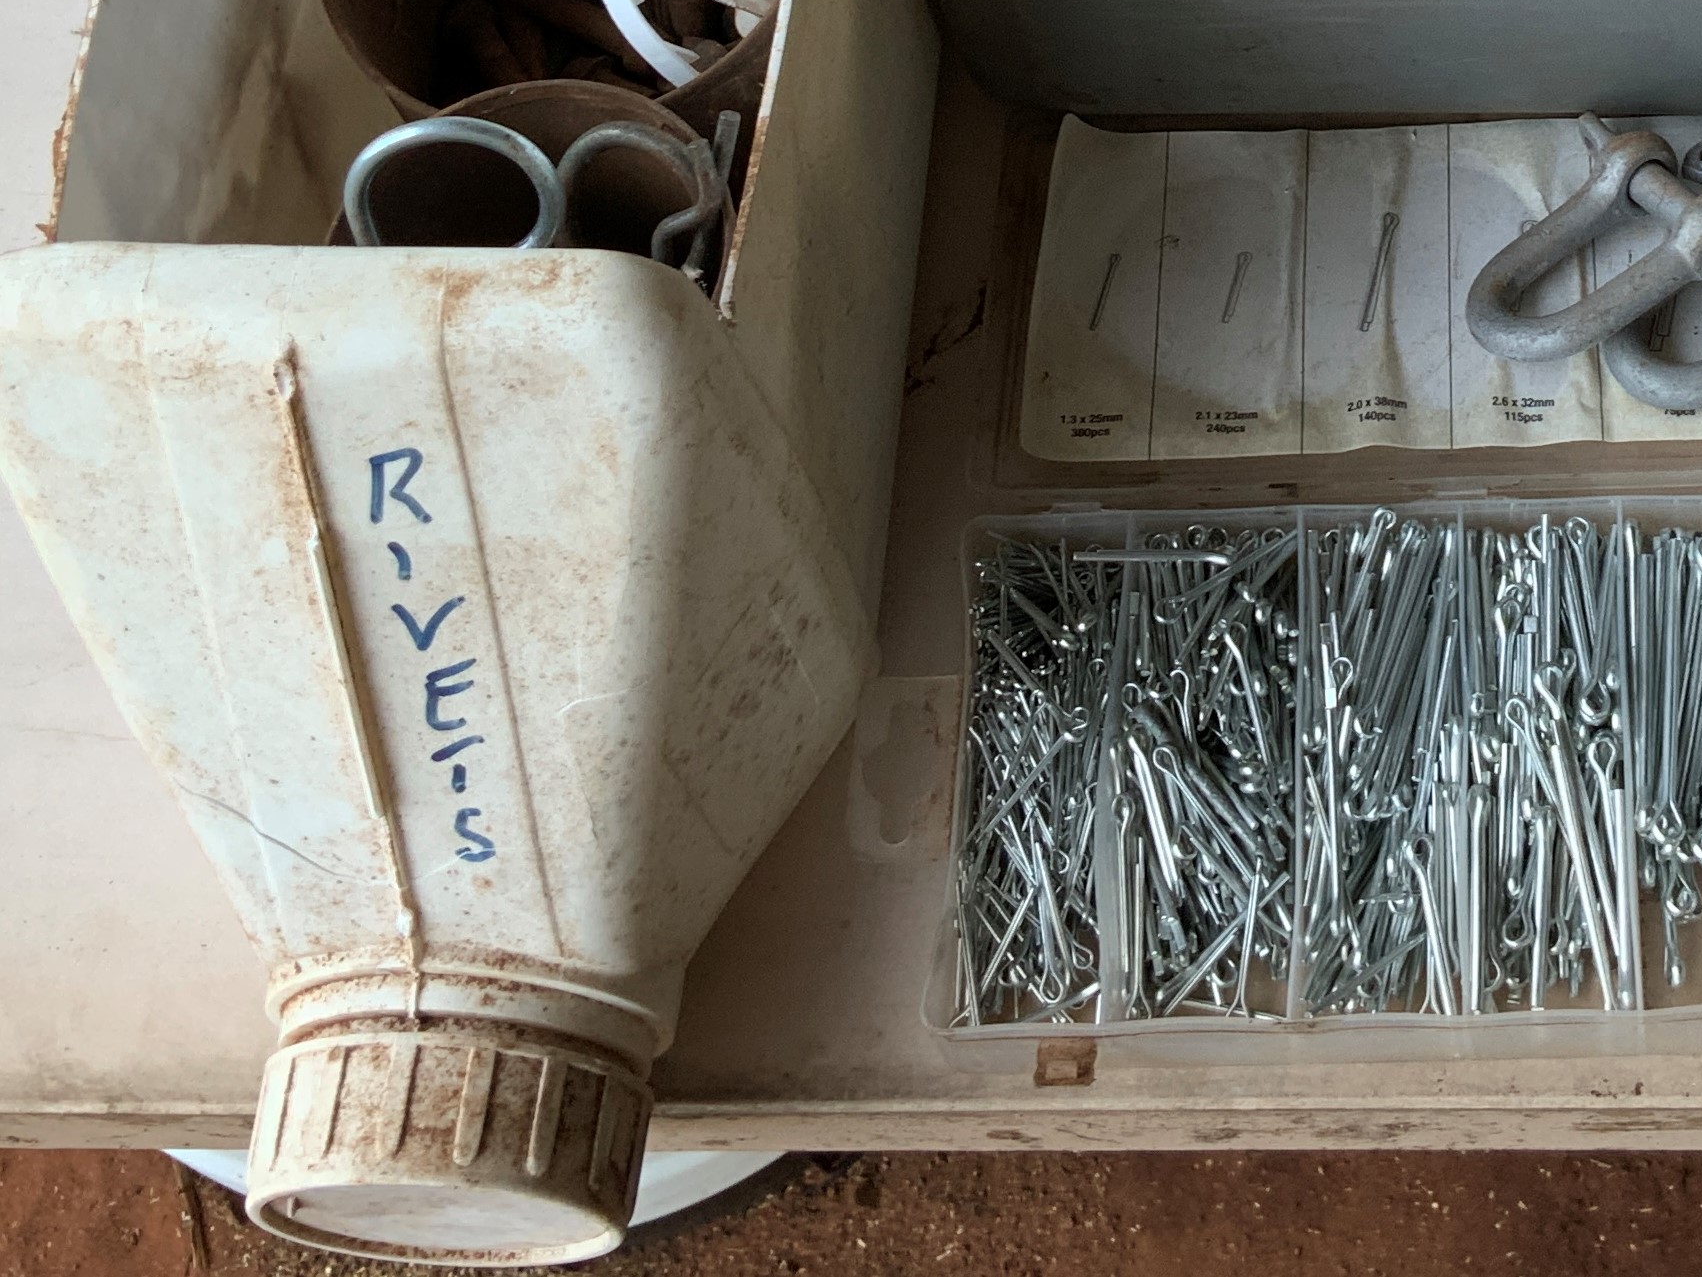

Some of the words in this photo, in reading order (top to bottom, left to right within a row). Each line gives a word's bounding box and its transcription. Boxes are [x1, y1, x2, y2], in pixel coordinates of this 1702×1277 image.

[1347, 400, 1363, 412] 2.0
[1365, 399, 1371, 407] x
[1374, 396, 1407, 409] 38mm
[1492, 396, 1509, 406] 2.6
[1511, 399, 1518, 407] x
[1520, 398, 1555, 407] 32mm
[1358, 411, 1396, 422] 140pcs
[1504, 412, 1543, 423] 115pcs
[1206, 424, 1246, 434] 240pcs
[369, 446, 497, 862] RIVETS
